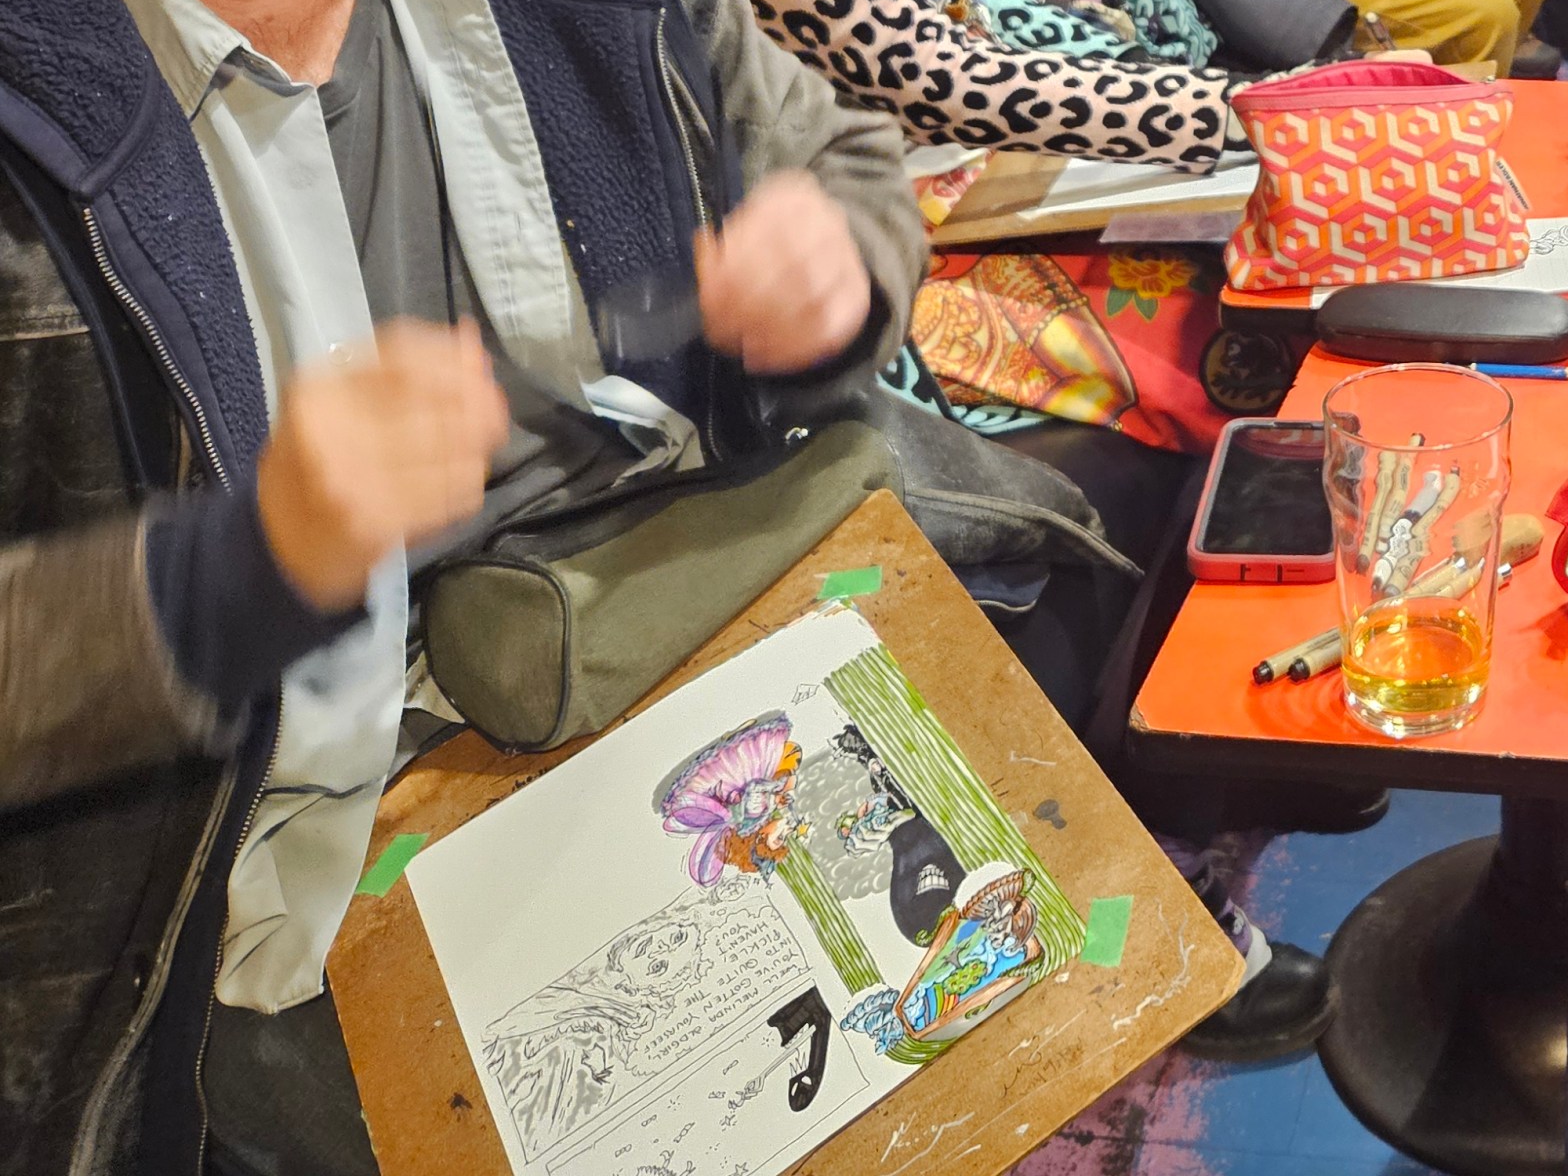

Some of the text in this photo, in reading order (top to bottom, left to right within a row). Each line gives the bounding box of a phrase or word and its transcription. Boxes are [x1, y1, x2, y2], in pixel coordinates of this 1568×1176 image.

[715, 923, 749, 947] YOU?
[718, 921, 769, 956] HAVEN'T
[684, 937, 792, 1008] INTO QUITE THE
[754, 948, 799, 977] YOU'VE
[763, 964, 798, 984] WELL
[703, 978, 752, 1013] GOTTEN
[708, 987, 758, 1022] MELINDA
